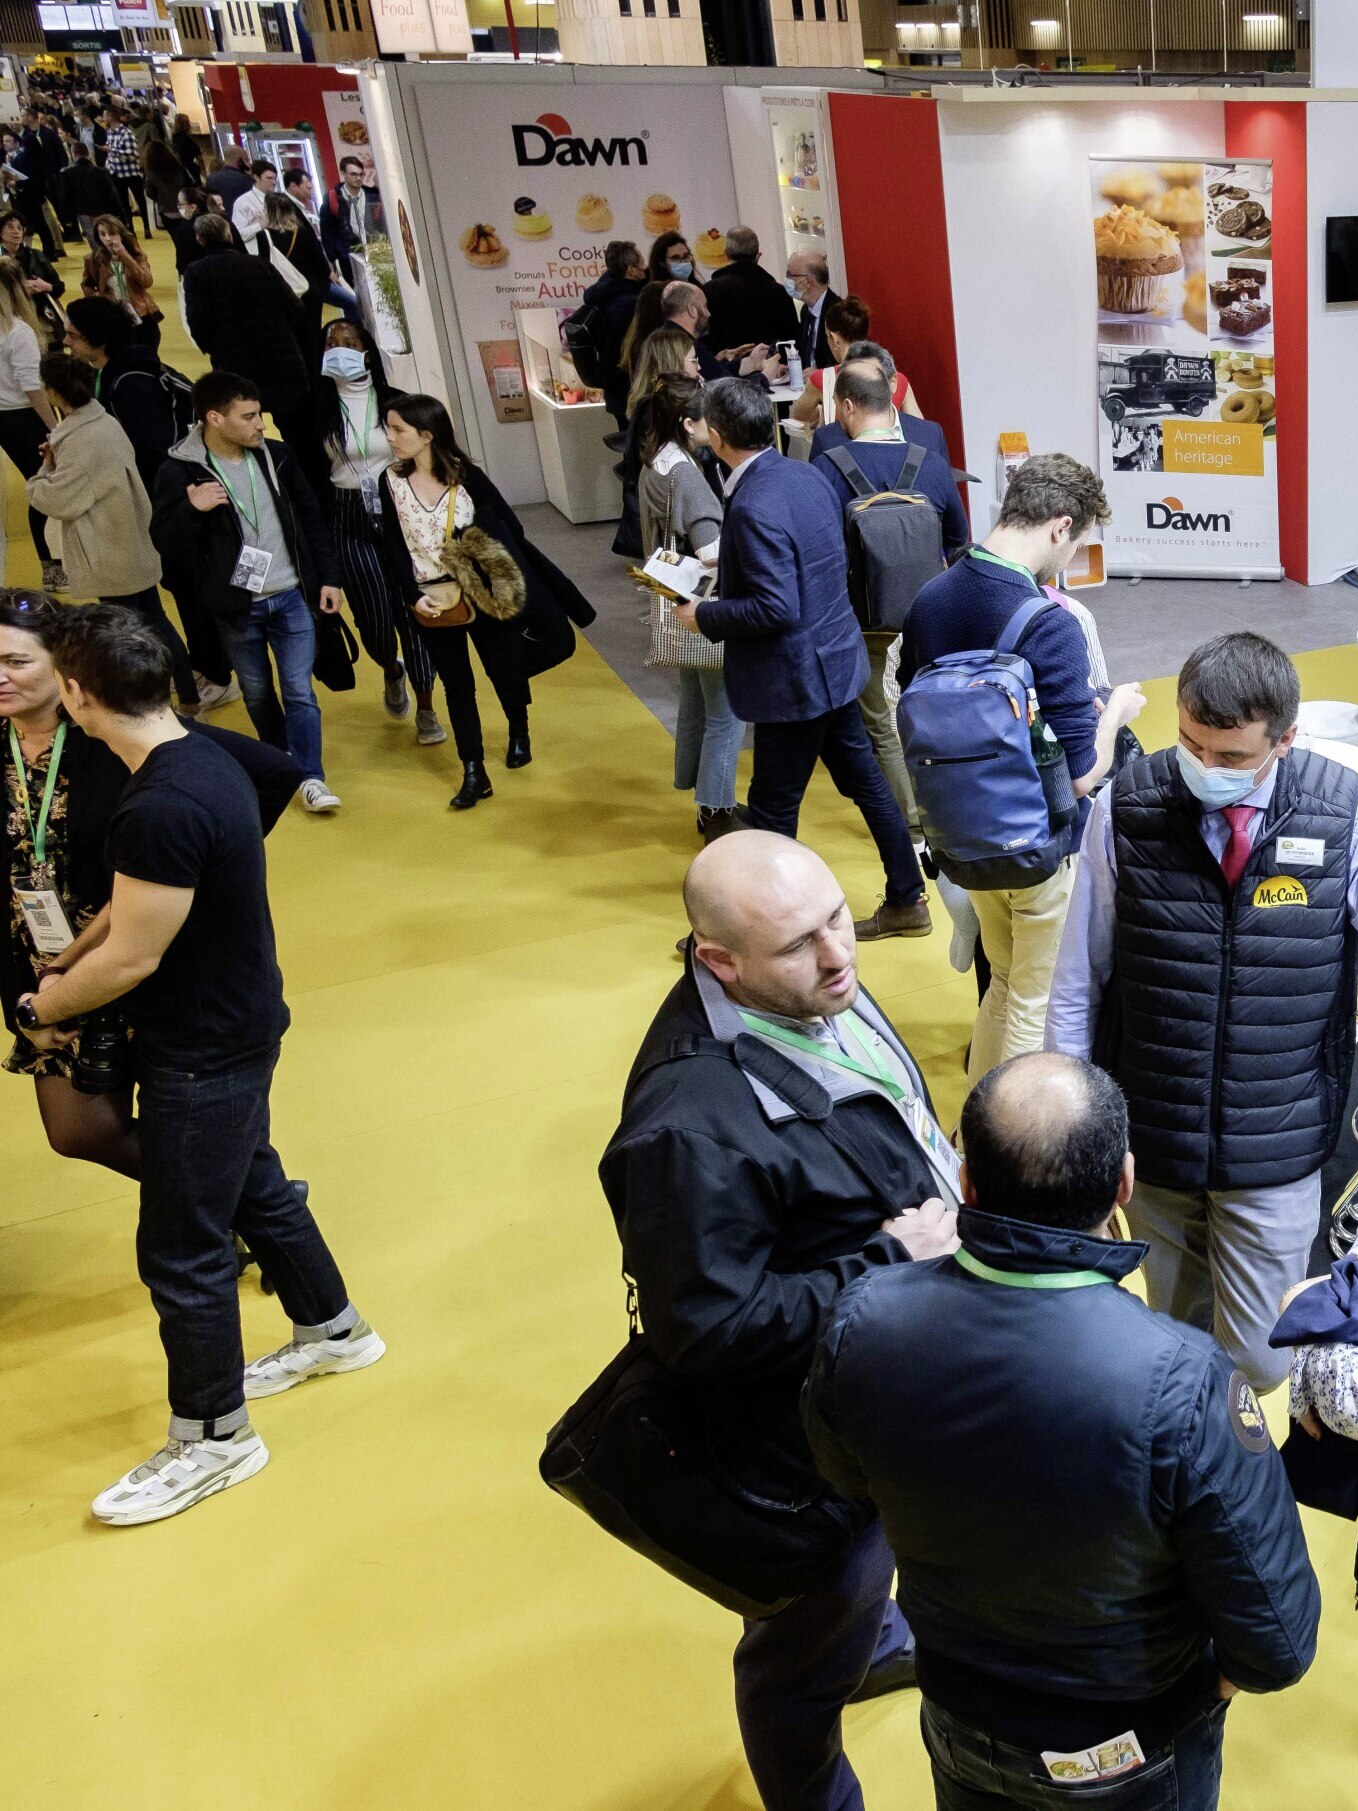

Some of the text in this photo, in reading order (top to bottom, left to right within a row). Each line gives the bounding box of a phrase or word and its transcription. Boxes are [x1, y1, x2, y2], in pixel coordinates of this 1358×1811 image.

[381, 0, 414, 16] Food
[511, 124, 648, 167] Dawn
[514, 272, 546, 280] Donuts
[495, 285, 536, 294] Brownies
[510, 299, 546, 310] Mixes
[1174, 429, 1241, 446] American
[1174, 448, 1233, 468] heritage
[1146, 502, 1231, 533] Dawn
[1115, 535, 1152, 545] Bakery
[1156, 538, 1197, 546] success
[1200, 538, 1231, 547] starts
[1258, 886, 1304, 904] McCain
